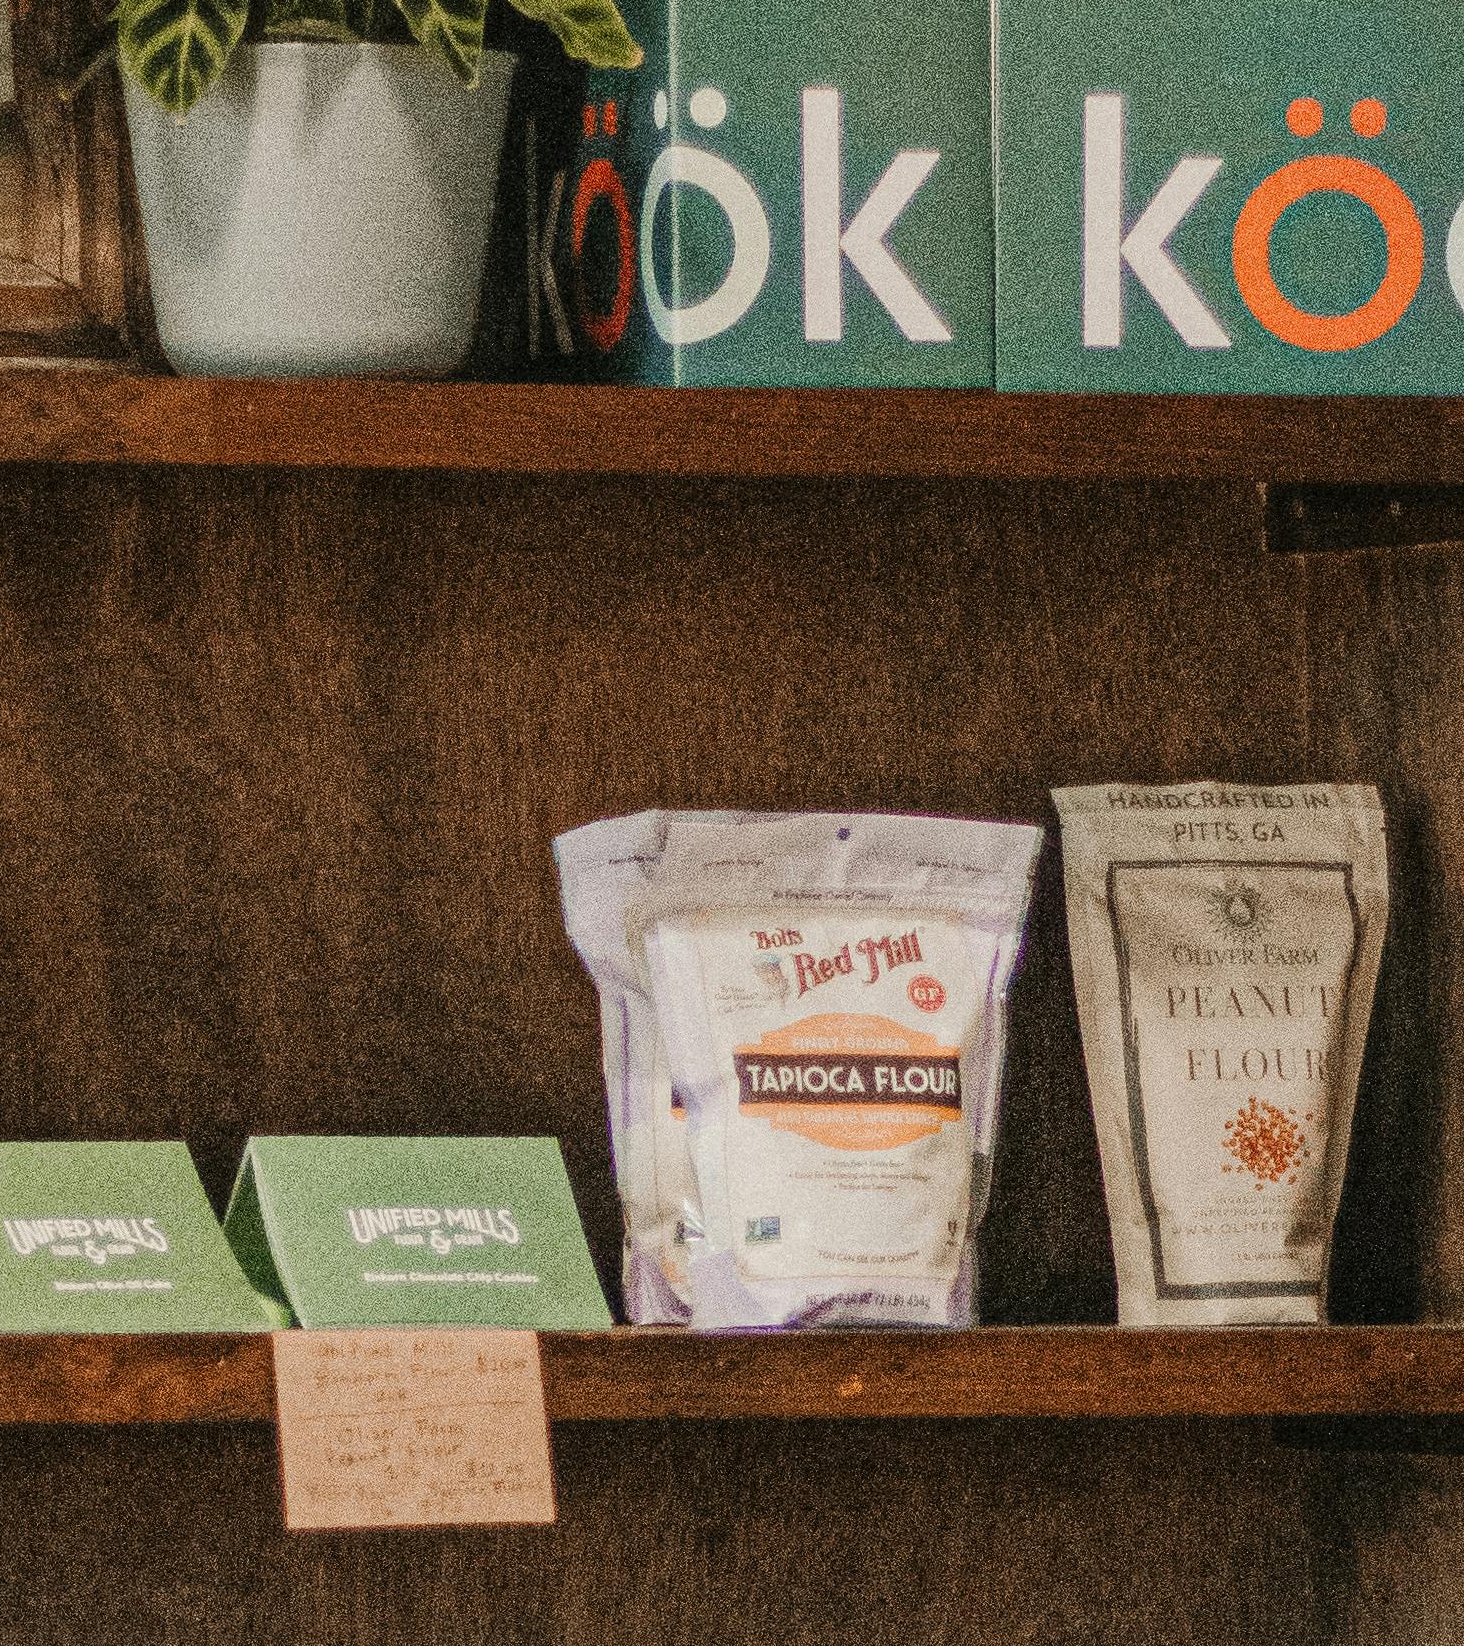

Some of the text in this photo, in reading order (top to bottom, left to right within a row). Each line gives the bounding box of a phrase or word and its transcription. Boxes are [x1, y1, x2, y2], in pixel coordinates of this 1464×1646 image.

[1107, 792, 1329, 809] HANDCRAFTED IN
[1253, 823, 1285, 843] GA
[750, 929, 803, 950] Bob's
[795, 932, 923, 998] Red Mill
[1165, 985, 1335, 1017] PEANUT
[746, 1065, 957, 1095] TAPIOCA FLOUR
[1187, 1047, 1328, 1081] FLOUR
[4, 1218, 168, 1255] UNIFIED MILLS
[348, 1207, 521, 1245] UNIFIED MILLS
